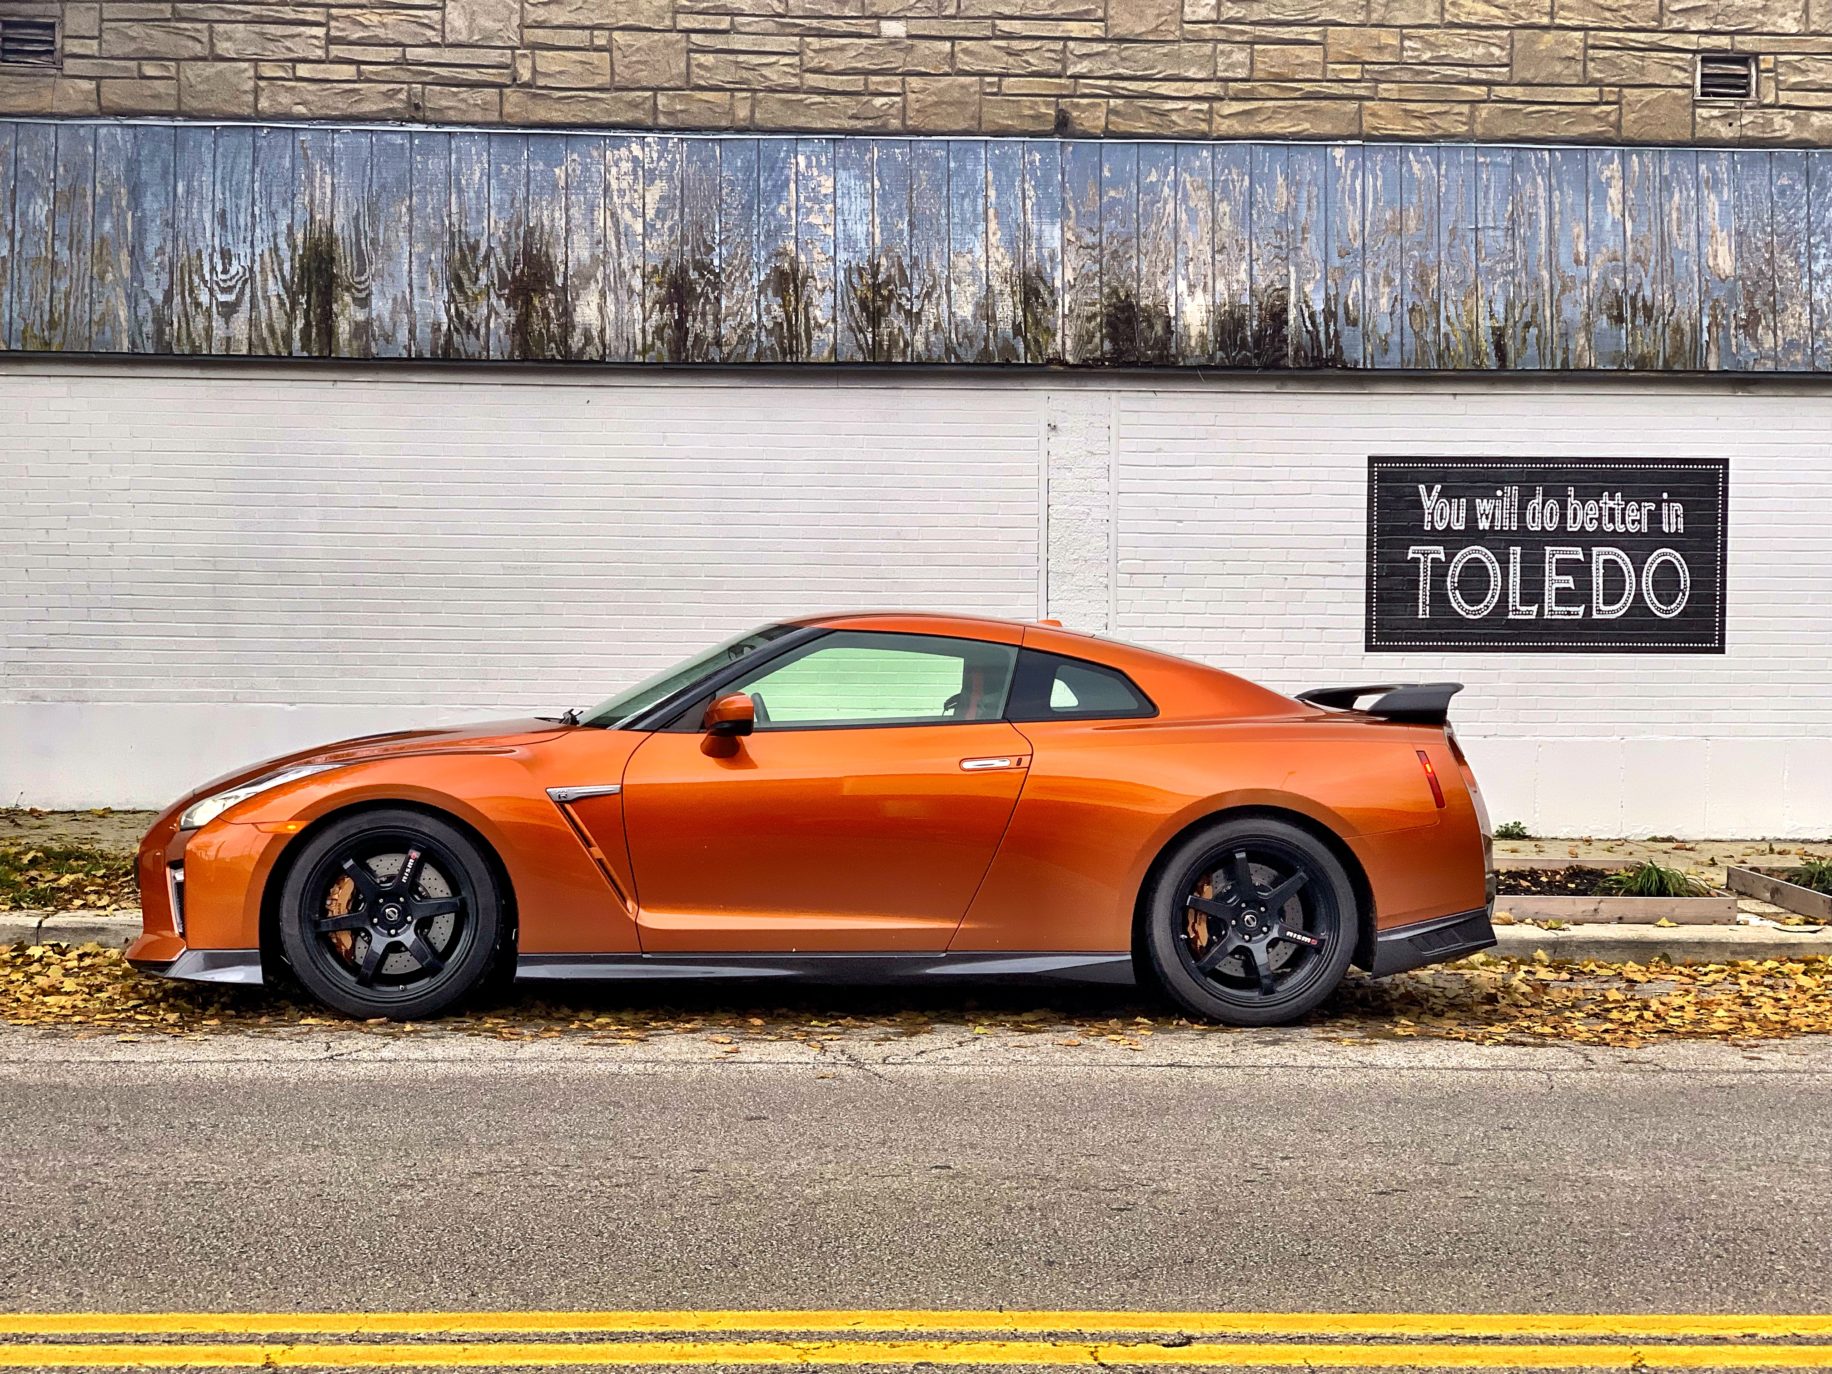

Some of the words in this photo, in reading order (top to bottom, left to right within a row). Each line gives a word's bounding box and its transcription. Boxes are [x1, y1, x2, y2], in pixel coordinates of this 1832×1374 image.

[1418, 484, 1466, 531] You
[1475, 486, 1519, 531] will
[1526, 486, 1560, 532] do
[1566, 486, 1656, 533] better
[1662, 492, 1684, 533] in
[1406, 545, 1690, 620] TOLEDO
